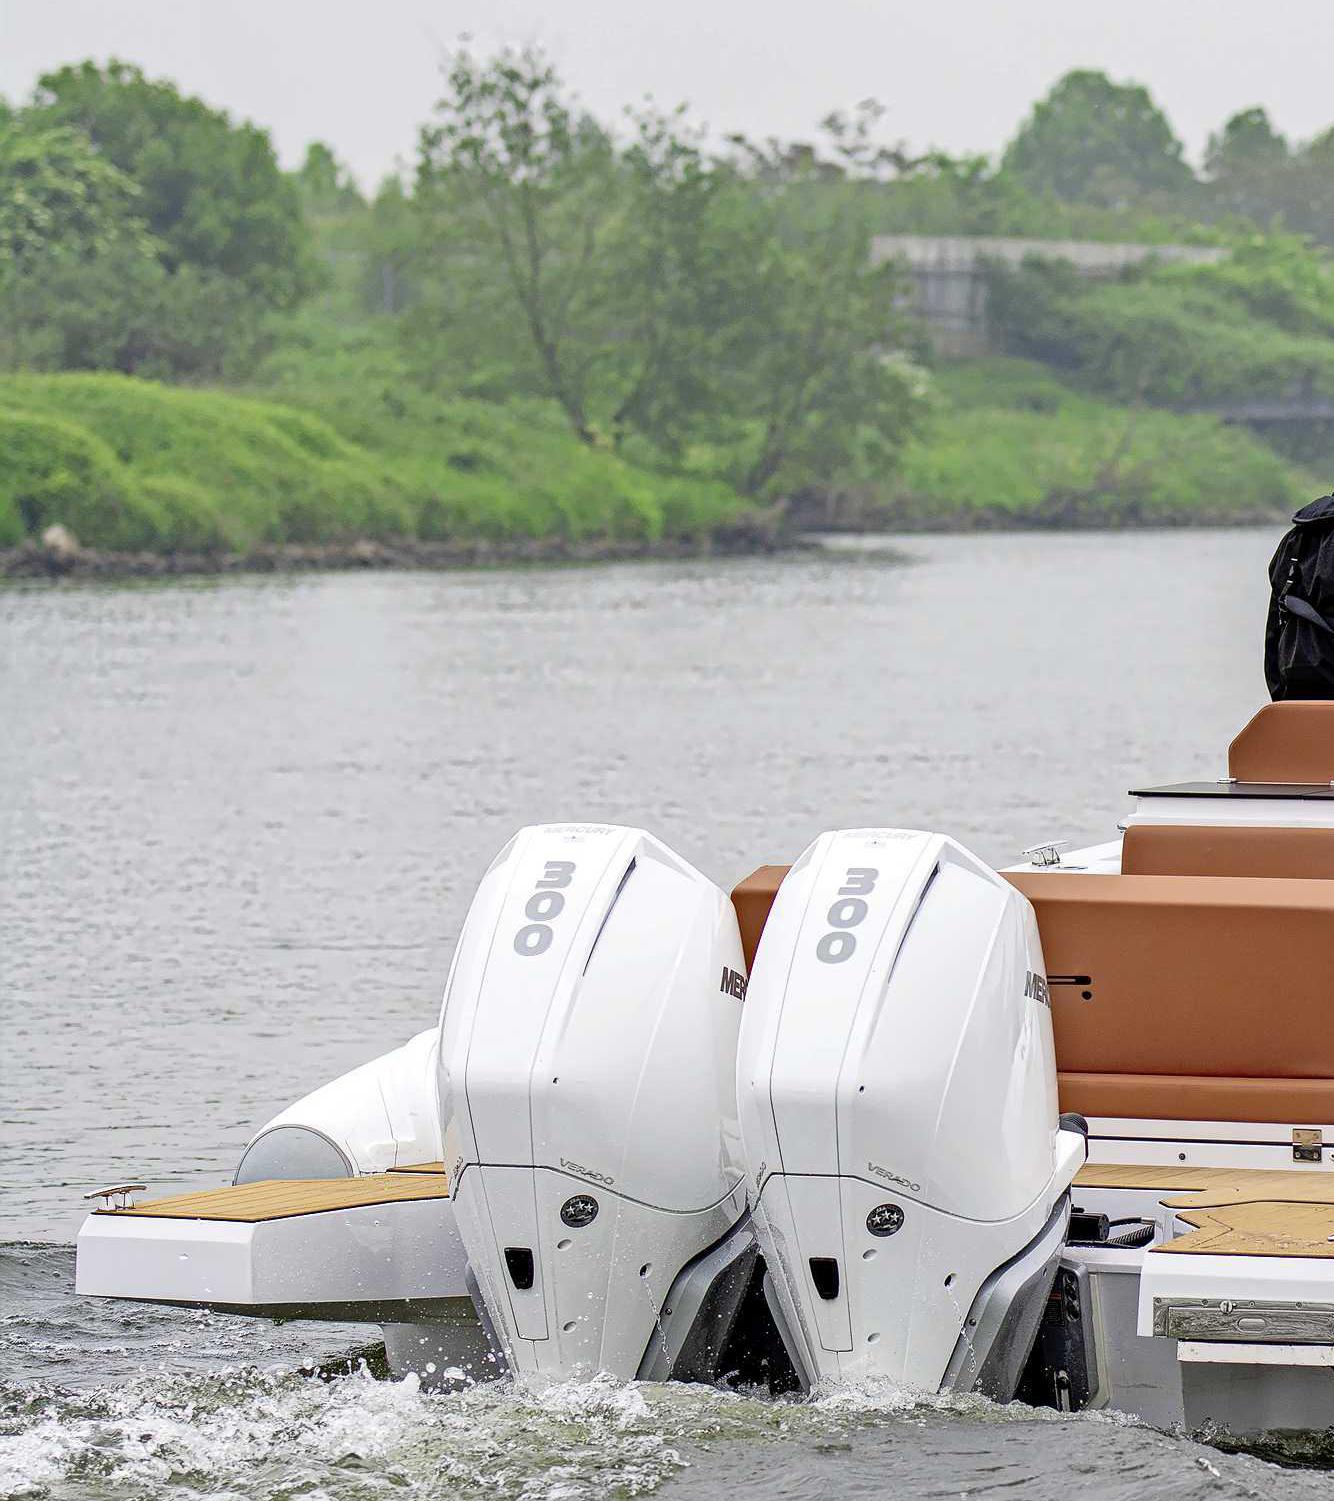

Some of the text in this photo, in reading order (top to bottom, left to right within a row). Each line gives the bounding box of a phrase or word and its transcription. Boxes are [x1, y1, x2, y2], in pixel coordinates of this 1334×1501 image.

[513, 860, 577, 957] 300
[816, 867, 880, 965] 300
[559, 1156, 616, 1186] VERADO
[867, 1161, 922, 1192] VERADO
